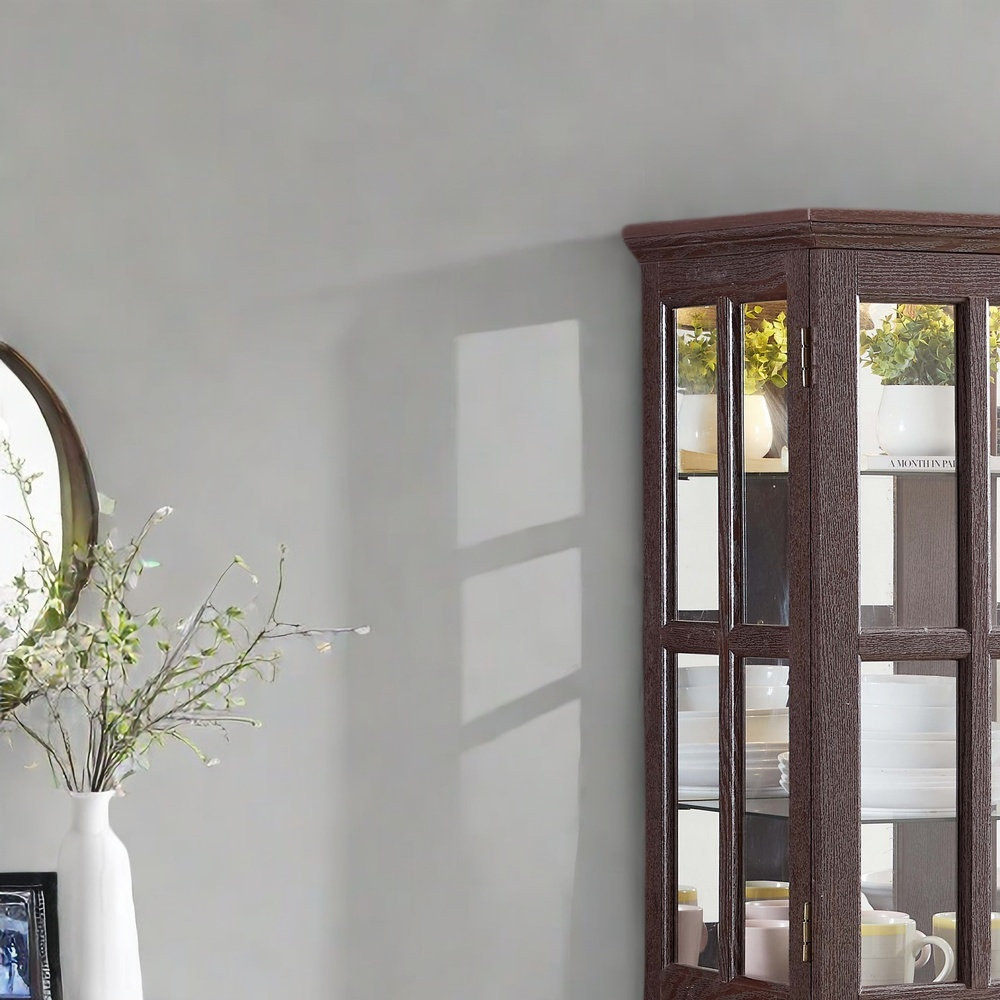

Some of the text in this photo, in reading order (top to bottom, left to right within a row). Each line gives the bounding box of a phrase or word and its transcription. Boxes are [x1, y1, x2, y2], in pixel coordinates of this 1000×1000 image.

[889, 459, 896, 468] A
[897, 459, 930, 468] MONTH
[931, 459, 942, 468] IN
